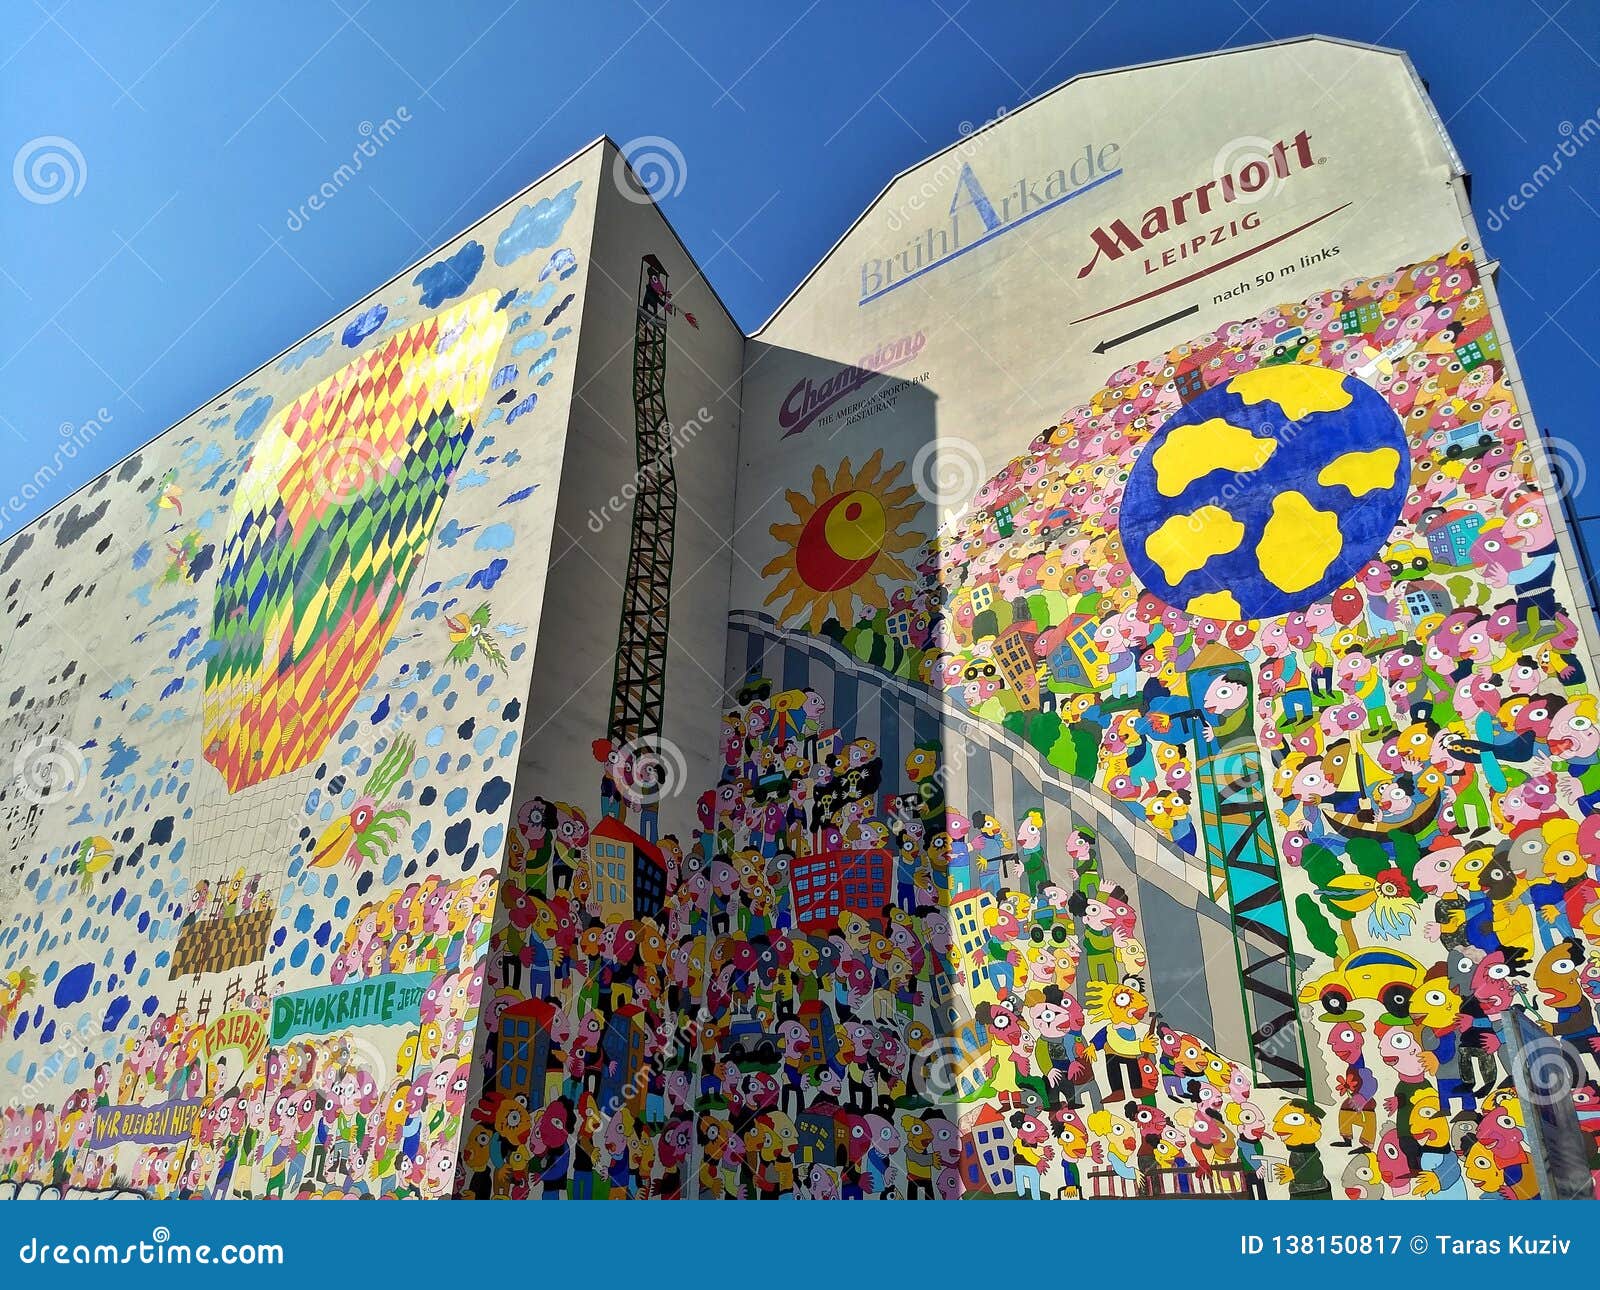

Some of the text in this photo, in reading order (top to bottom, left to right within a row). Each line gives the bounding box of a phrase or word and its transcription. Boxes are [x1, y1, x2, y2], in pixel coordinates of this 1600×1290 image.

[1077, 129, 1315, 279] Marriott
[1143, 211, 1262, 275] LEIPZIG
[1212, 245, 1341, 304] nach 50 m links
[778, 329, 928, 434] Champions
[818, 371, 931, 428] THE AMERICAN SPORTS BAR
[845, 396, 898, 426] RESTAURANT
[273, 980, 397, 1040] DEMOKRATIE
[96, 1110, 122, 1142] WIR
[121, 1107, 170, 1137] BLEIBEN
